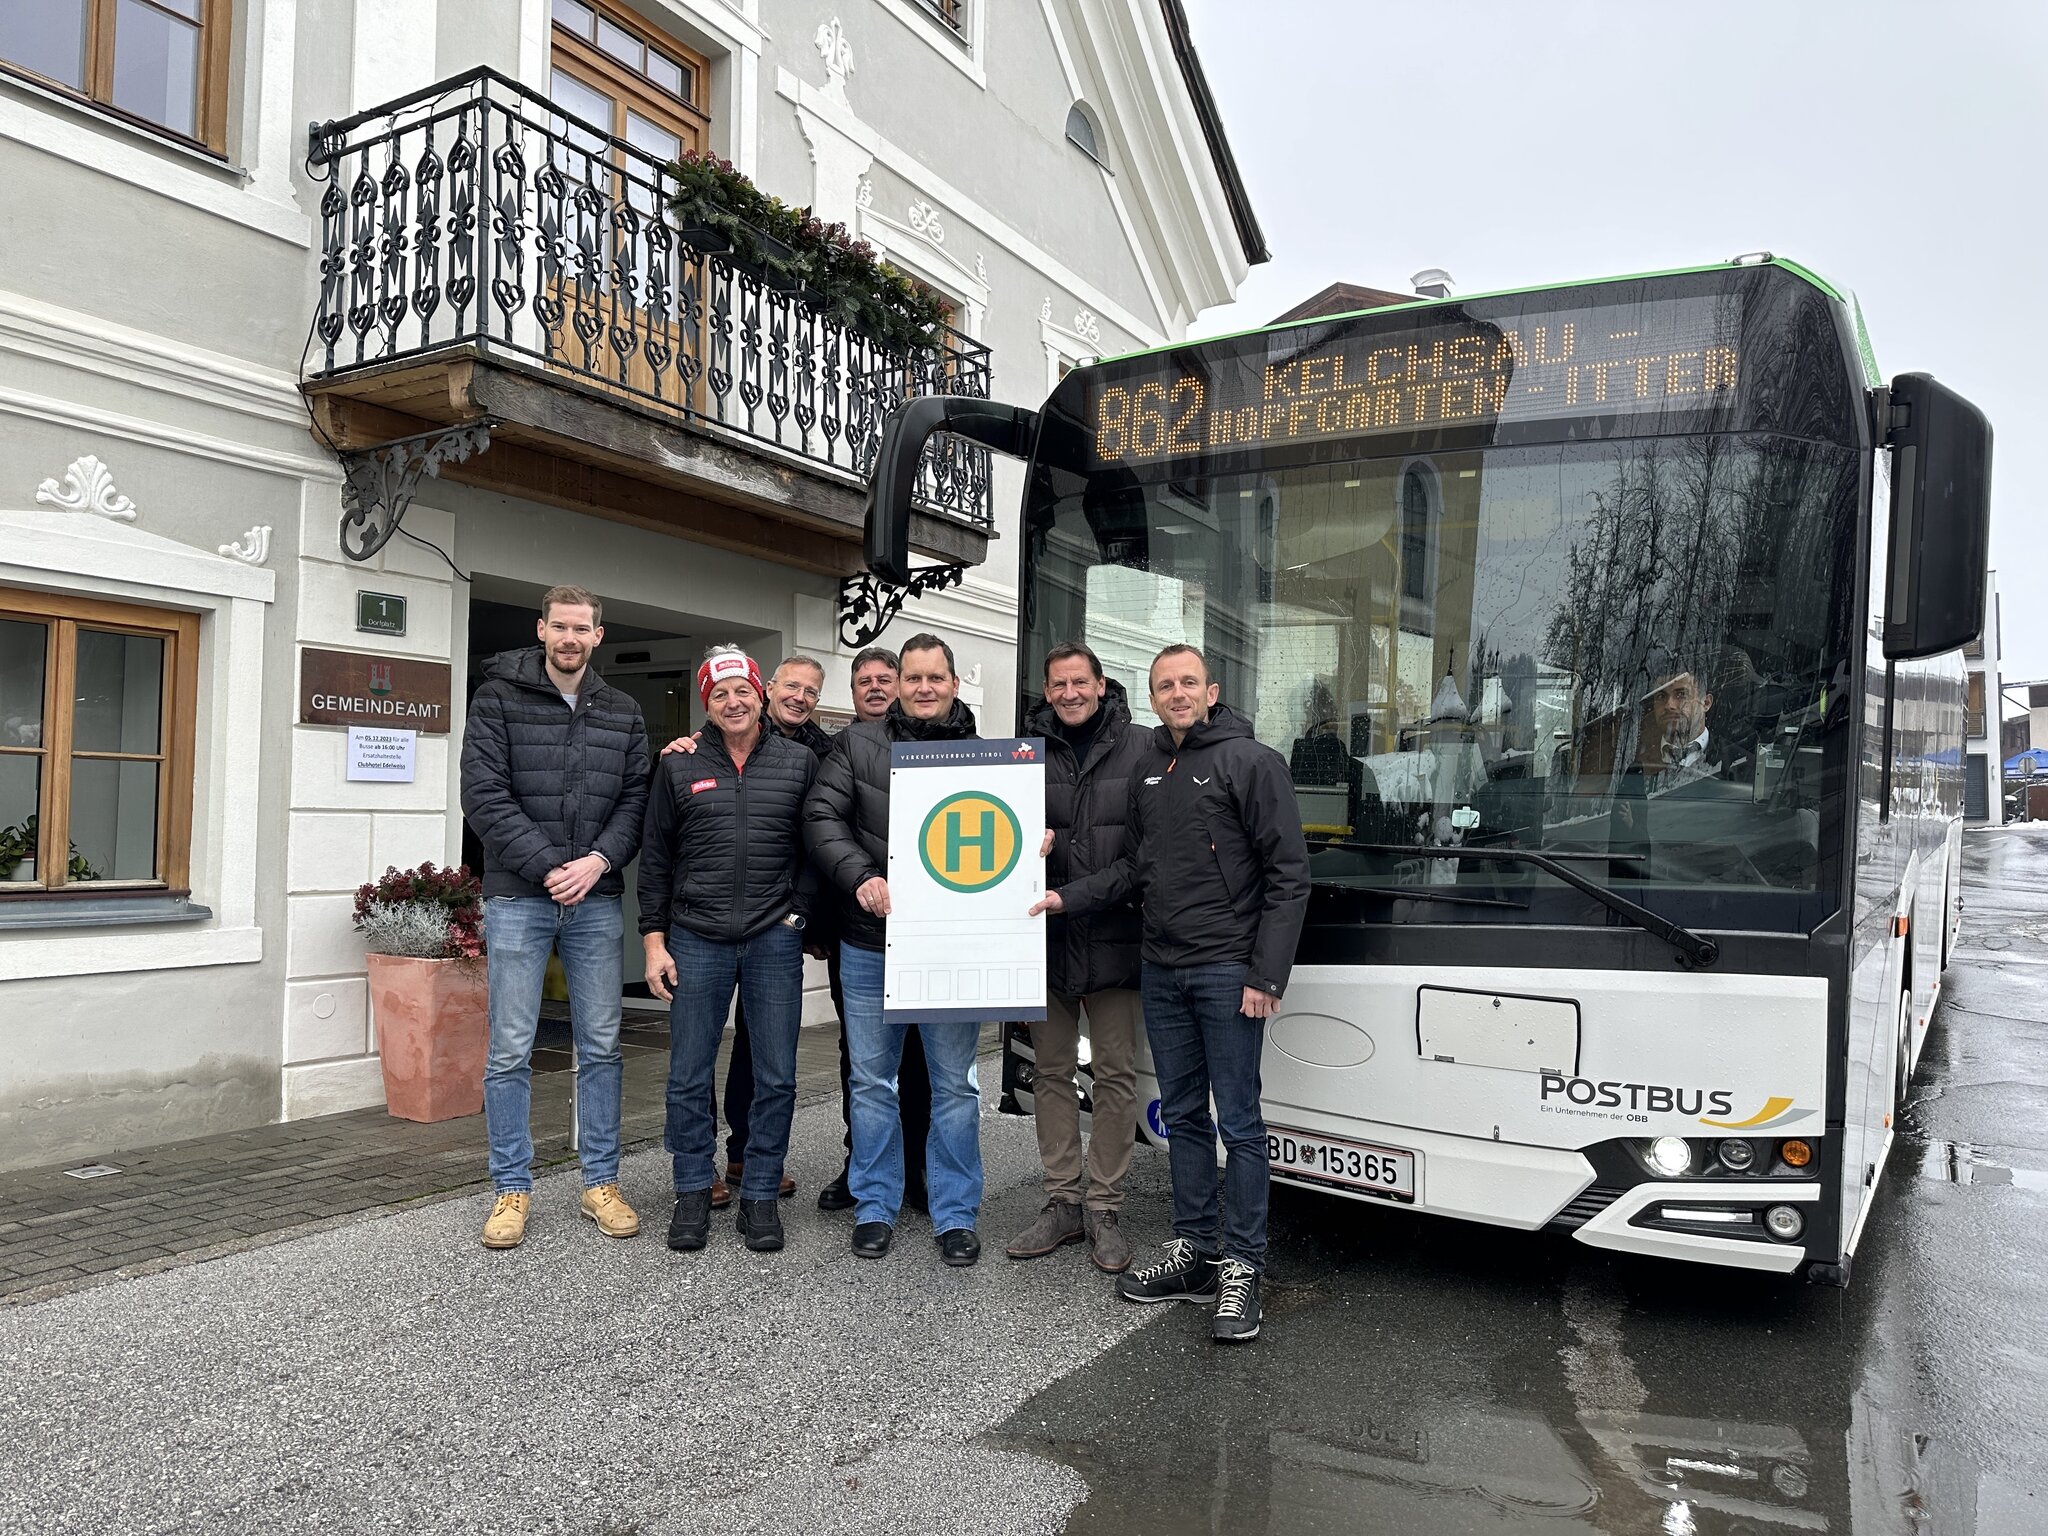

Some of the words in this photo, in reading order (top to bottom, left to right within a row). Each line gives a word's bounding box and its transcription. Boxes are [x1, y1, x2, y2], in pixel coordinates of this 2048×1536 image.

[1264, 323, 1575, 400] KELCHSAU
[1209, 375, 1506, 446] HOPFGARTEN
[1566, 348, 1737, 405] ITTER
[1096, 376, 1204, 461] 862
[368, 618, 396, 628] Dorfplatz
[379, 600, 387, 616] 1
[311, 694, 442, 718] GEMEINDEAMT
[901, 752, 976, 760] VERKEHRSVERBUND
[945, 811, 995, 872] H
[1540, 1075, 1733, 1116] POSTBUS
[1540, 1104, 1553, 1113] Ein
[1555, 1106, 1608, 1120] Unternehmen
[1610, 1112, 1623, 1121] der
[1268, 1135, 1297, 1164] BD
[1318, 1145, 1397, 1184] 15365
